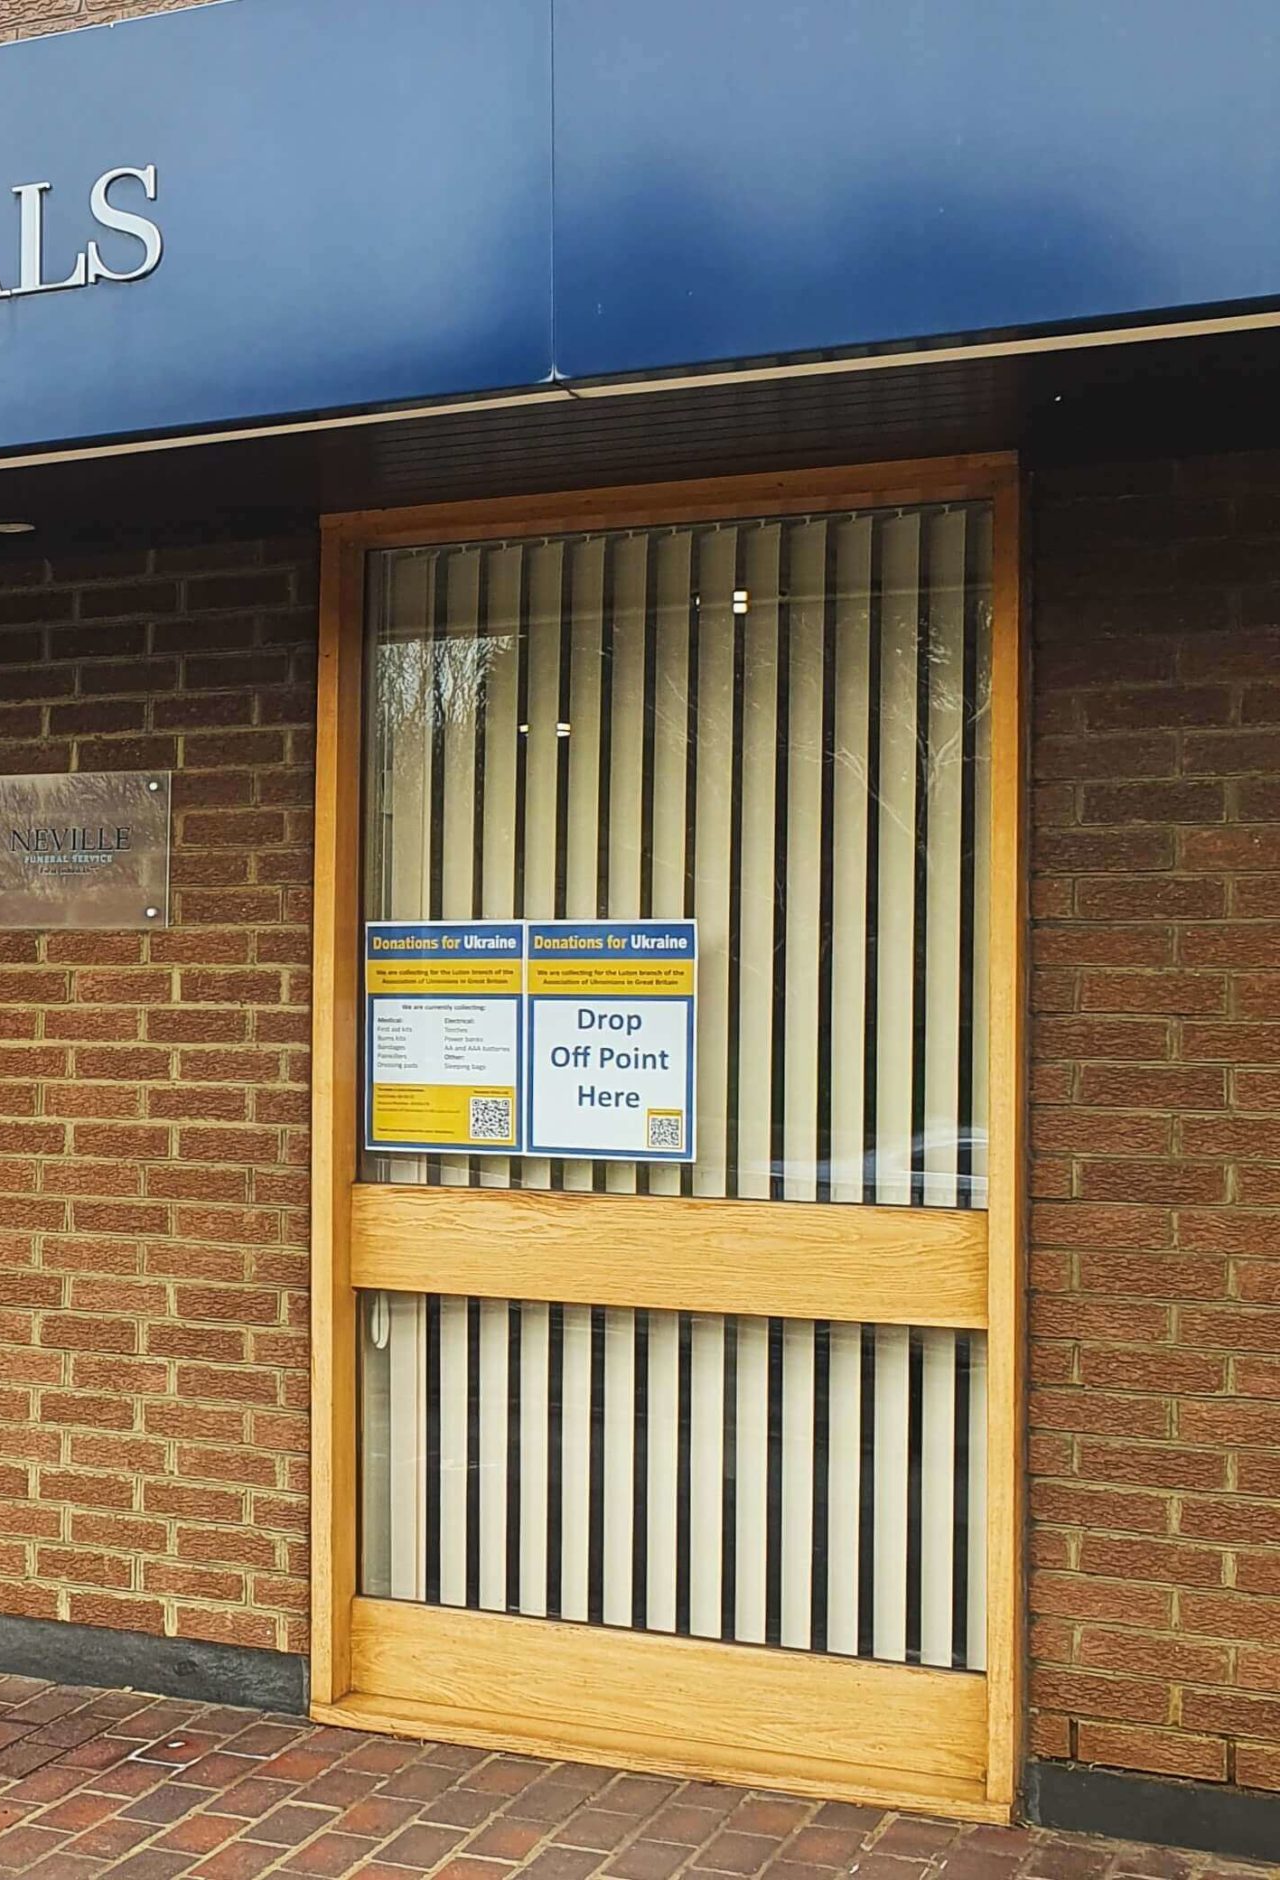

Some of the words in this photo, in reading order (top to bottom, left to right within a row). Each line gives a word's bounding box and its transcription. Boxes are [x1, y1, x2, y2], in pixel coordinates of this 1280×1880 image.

[11, 827, 130, 851] NEVILLE
[24, 855, 68, 863] FUNERAL
[72, 854, 112, 863] SERVICE
[373, 936, 438, 950] Donations
[441, 935, 461, 949] for
[464, 935, 516, 949] Ukraine
[534, 934, 603, 949] Donations
[607, 934, 628, 949] for
[631, 934, 687, 949] Ukraine
[399, 969, 428, 977] collecting
[561, 969, 592, 977] collecting
[578, 1008, 642, 1036] Drop
[551, 1046, 591, 1068] Off
[599, 1047, 670, 1070] Point
[578, 1085, 640, 1108] Here
